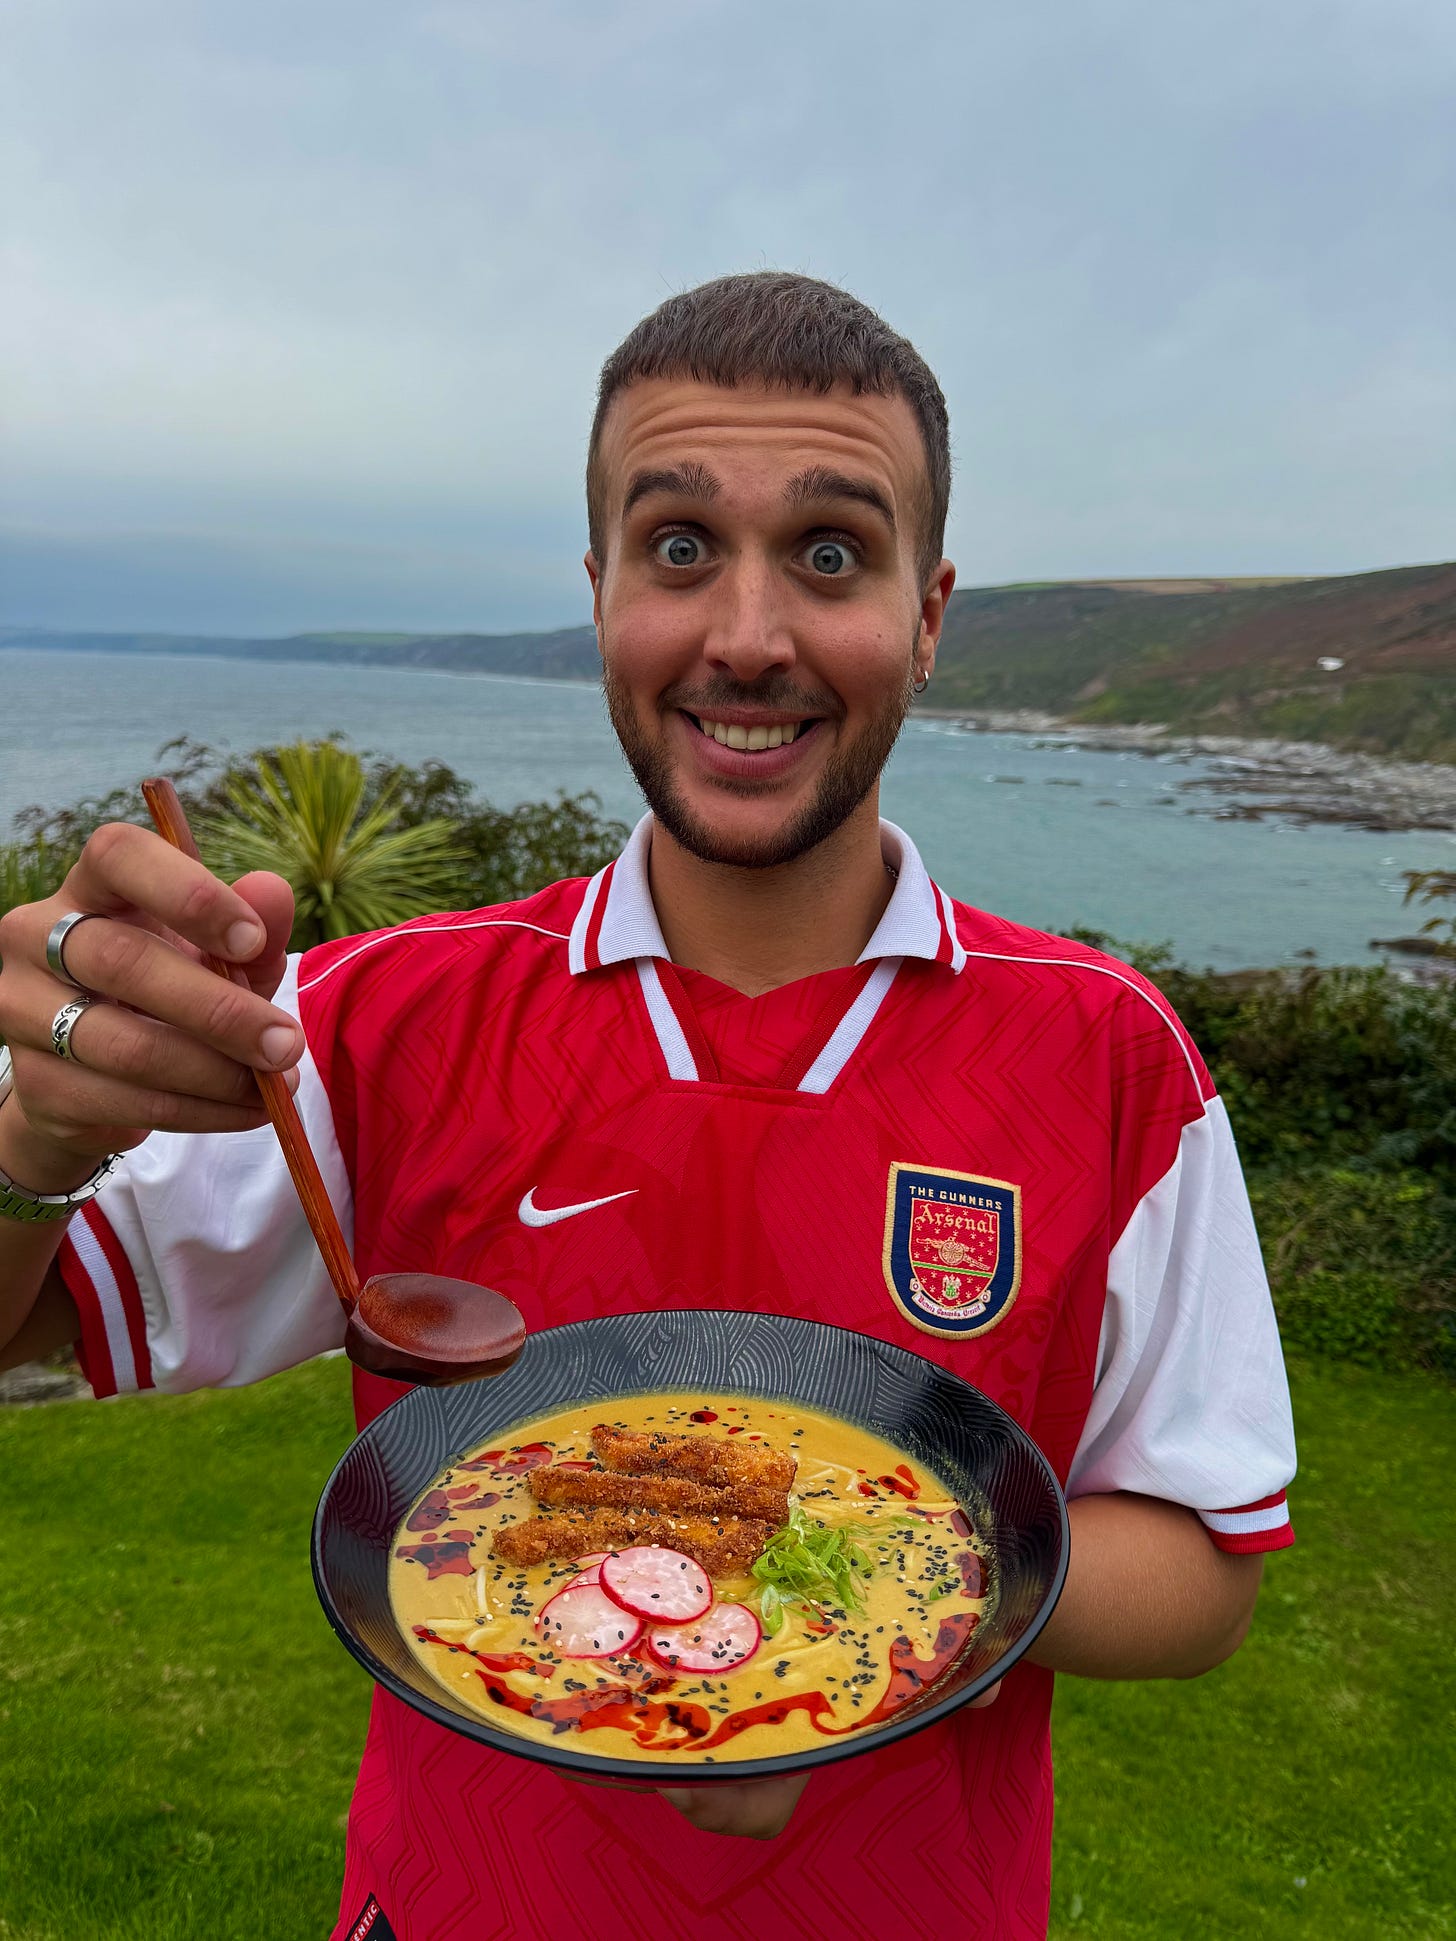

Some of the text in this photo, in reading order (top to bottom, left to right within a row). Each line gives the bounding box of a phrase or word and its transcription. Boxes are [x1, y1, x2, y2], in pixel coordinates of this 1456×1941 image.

[909, 1185, 1003, 1210] THE GUNNERS
[914, 1203, 996, 1234] Arsenal
